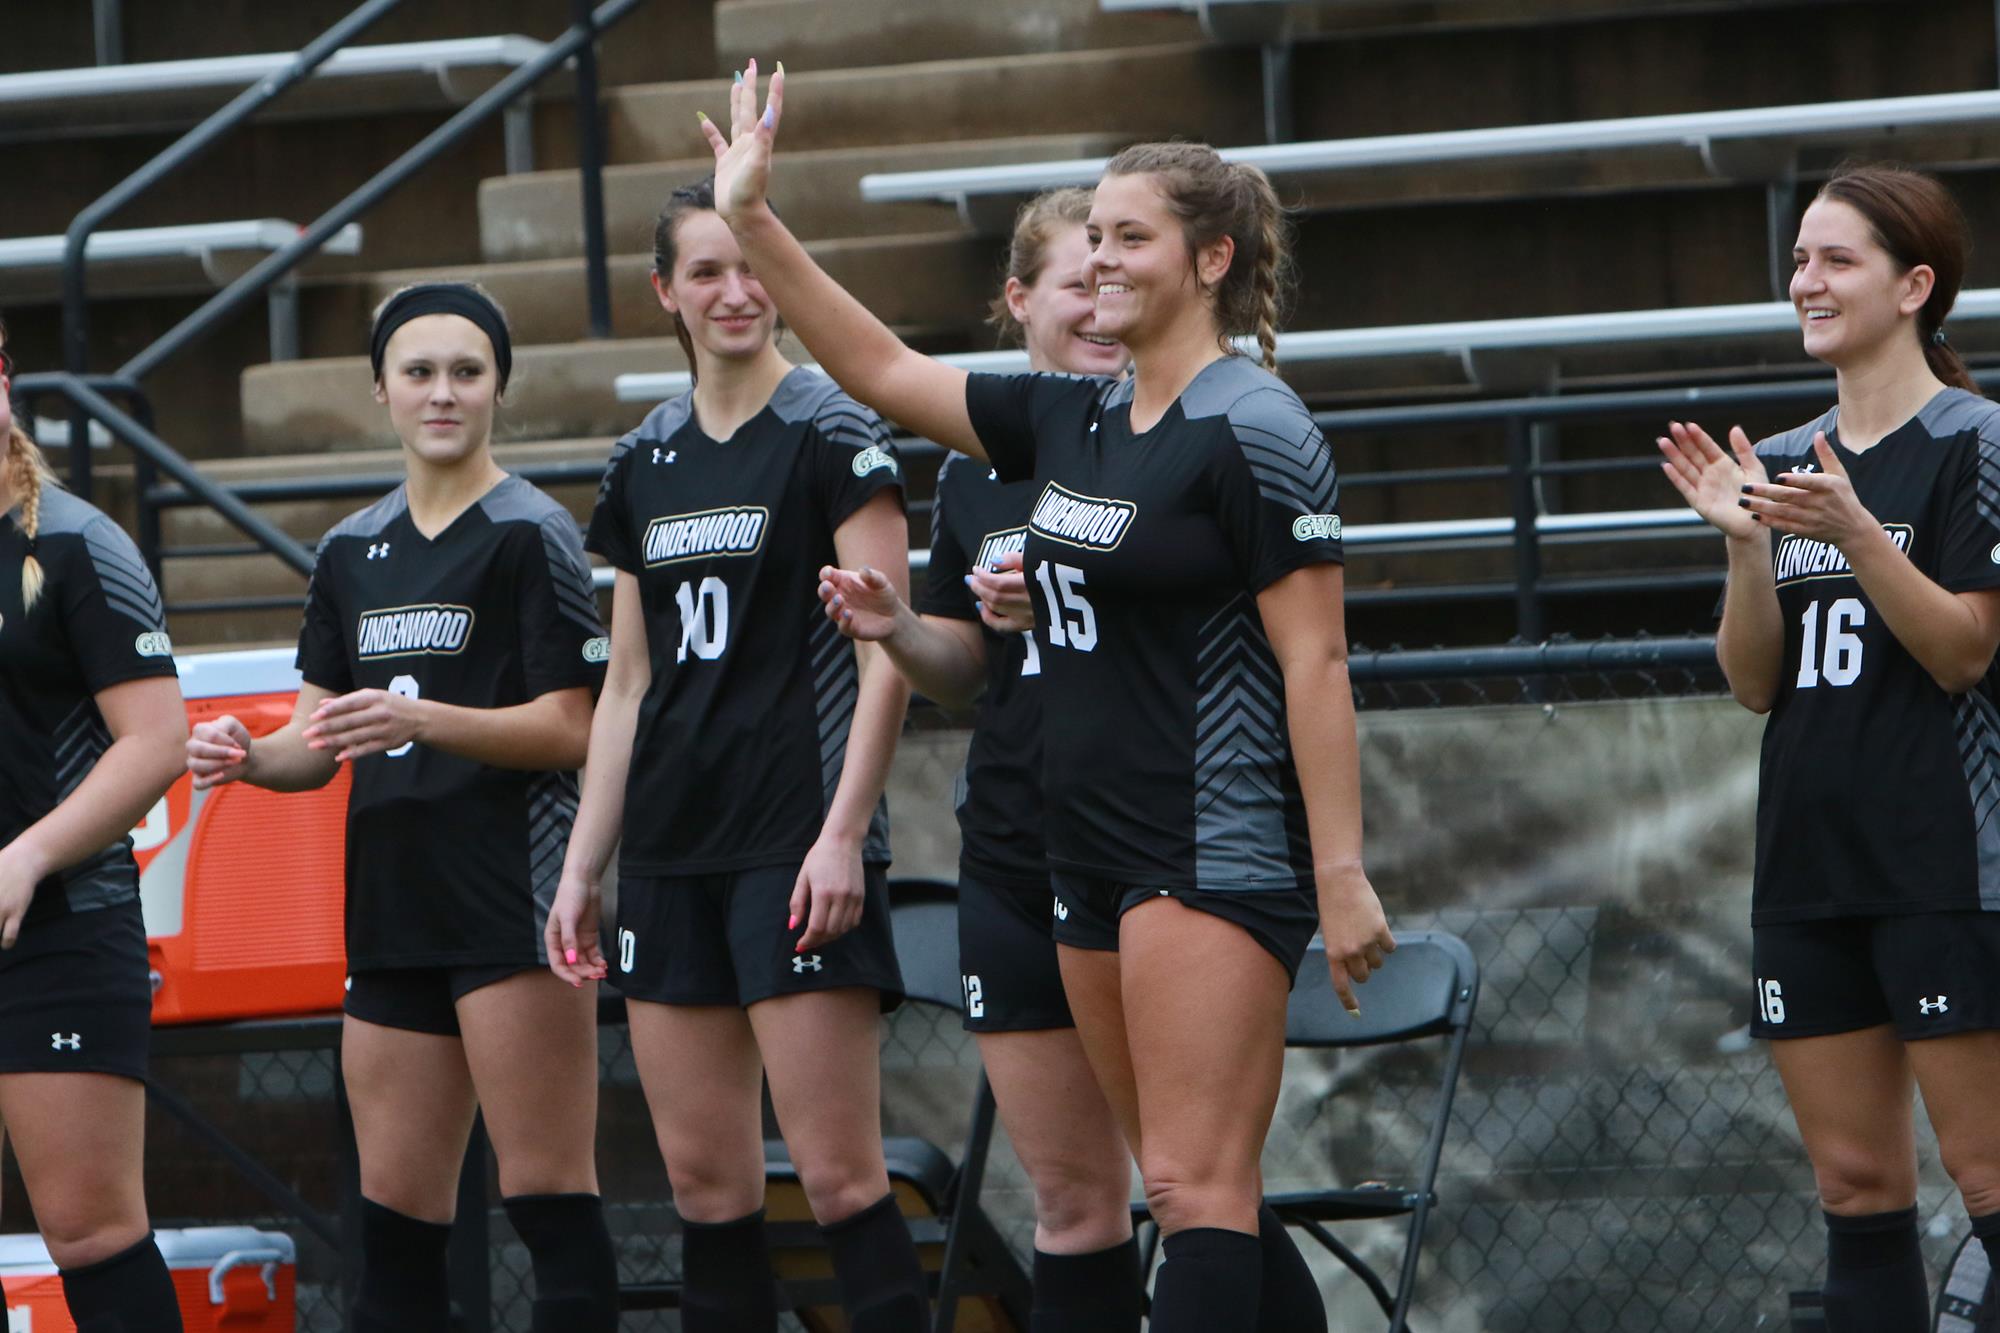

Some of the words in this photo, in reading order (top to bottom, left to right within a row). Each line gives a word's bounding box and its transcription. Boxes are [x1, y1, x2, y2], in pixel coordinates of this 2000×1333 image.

[646, 512, 763, 561] LINDENWOOD
[1032, 489, 1130, 544] LINDENWOOD
[359, 610, 468, 654] LINDENWOOD
[675, 576, 729, 664] 10
[1035, 560, 1097, 652] 15
[1796, 598, 1866, 689] 16
[1758, 978, 1785, 1023] 16
